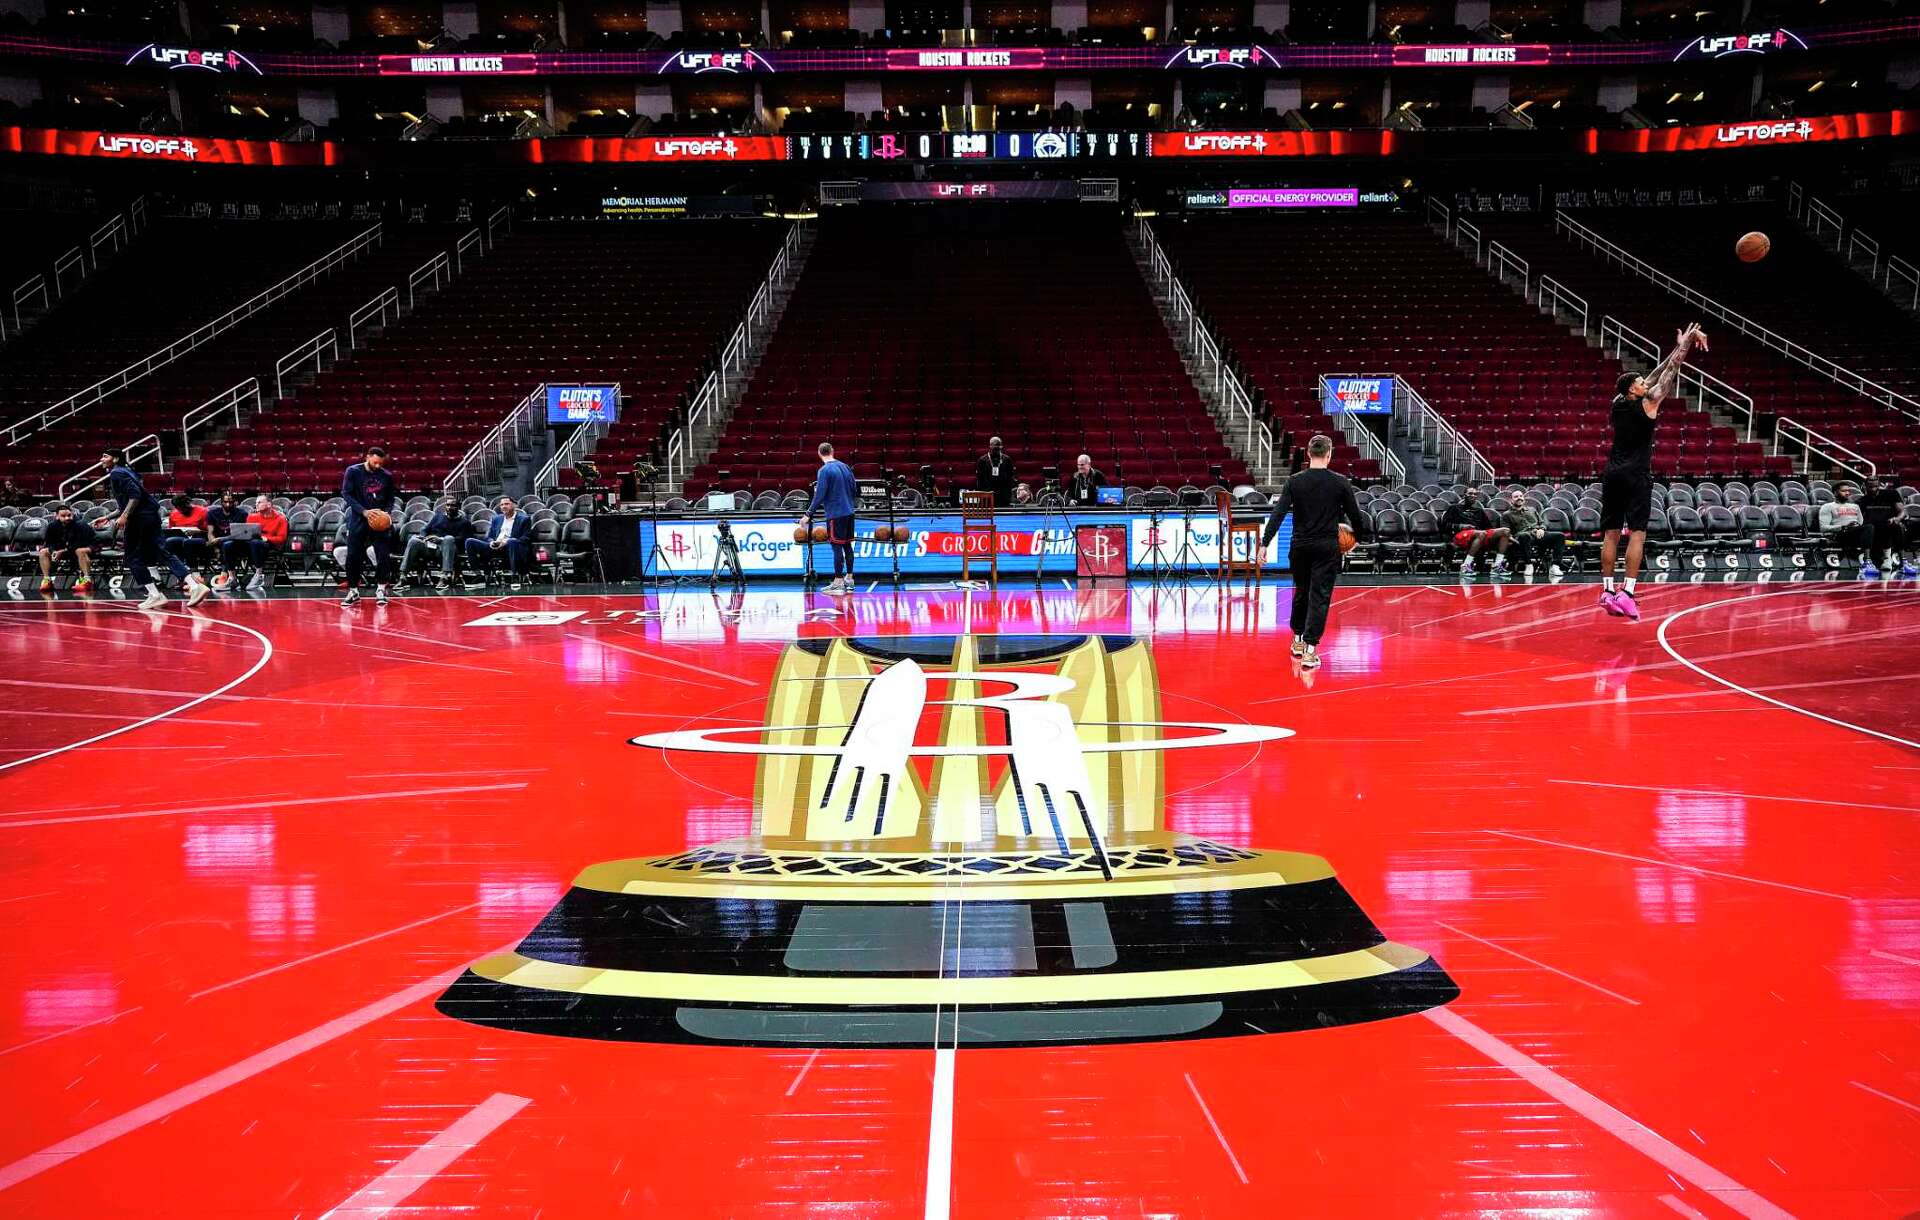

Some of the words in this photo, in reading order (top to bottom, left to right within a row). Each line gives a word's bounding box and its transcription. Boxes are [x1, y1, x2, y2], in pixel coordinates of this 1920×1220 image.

[1700, 33, 1771, 52] LIFTOFF
[151, 47, 224, 66] LIFTOFF
[680, 53, 741, 67] LIFTOFF
[919, 51, 962, 66] HOUSTON
[967, 51, 1010, 66] ROCKETS
[1187, 48, 1249, 63] LIFTOFF
[1425, 48, 1468, 62] HOUSTON
[1472, 48, 1516, 62] ROCKETS
[411, 57, 455, 72] HOUSTON
[459, 57, 503, 71] ROCKETS
[1717, 122, 1795, 141] LIFTOFF
[99, 136, 179, 154] LIFTOFF
[655, 140, 722, 155] LIFTOFF
[920, 135, 929, 158] 0
[1010, 134, 1020, 157] 0
[1089, 143, 1095, 156] 7
[1131, 143, 1137, 156] 1
[1185, 135, 1252, 150] LIFTOFF
[602, 197, 644, 207] MEMORIAL
[645, 196, 687, 205] HERMANN
[1187, 193, 1217, 204] reliant
[1232, 194, 1273, 203] OFFICIAL
[1274, 193, 1310, 203] ENERGY
[1311, 193, 1354, 202] PROVIDER
[1360, 192, 1389, 203] reliant
[1338, 380, 1380, 393] CLUTCH'S
[560, 389, 602, 402] CLUTCH'S
[739, 531, 793, 561] Kroger
[843, 530, 929, 557] LUTCH'S
[942, 533, 1020, 553] GROCRY
[1030, 529, 1076, 555] GAM
[1656, 555, 1669, 568] G
[1691, 554, 1705, 568] G
[1725, 554, 1739, 568] G
[1759, 554, 1773, 568] G
[1792, 554, 1806, 567] G
[1826, 553, 1840, 567] G
[6, 576, 21, 590] G
[108, 575, 123, 589] G
